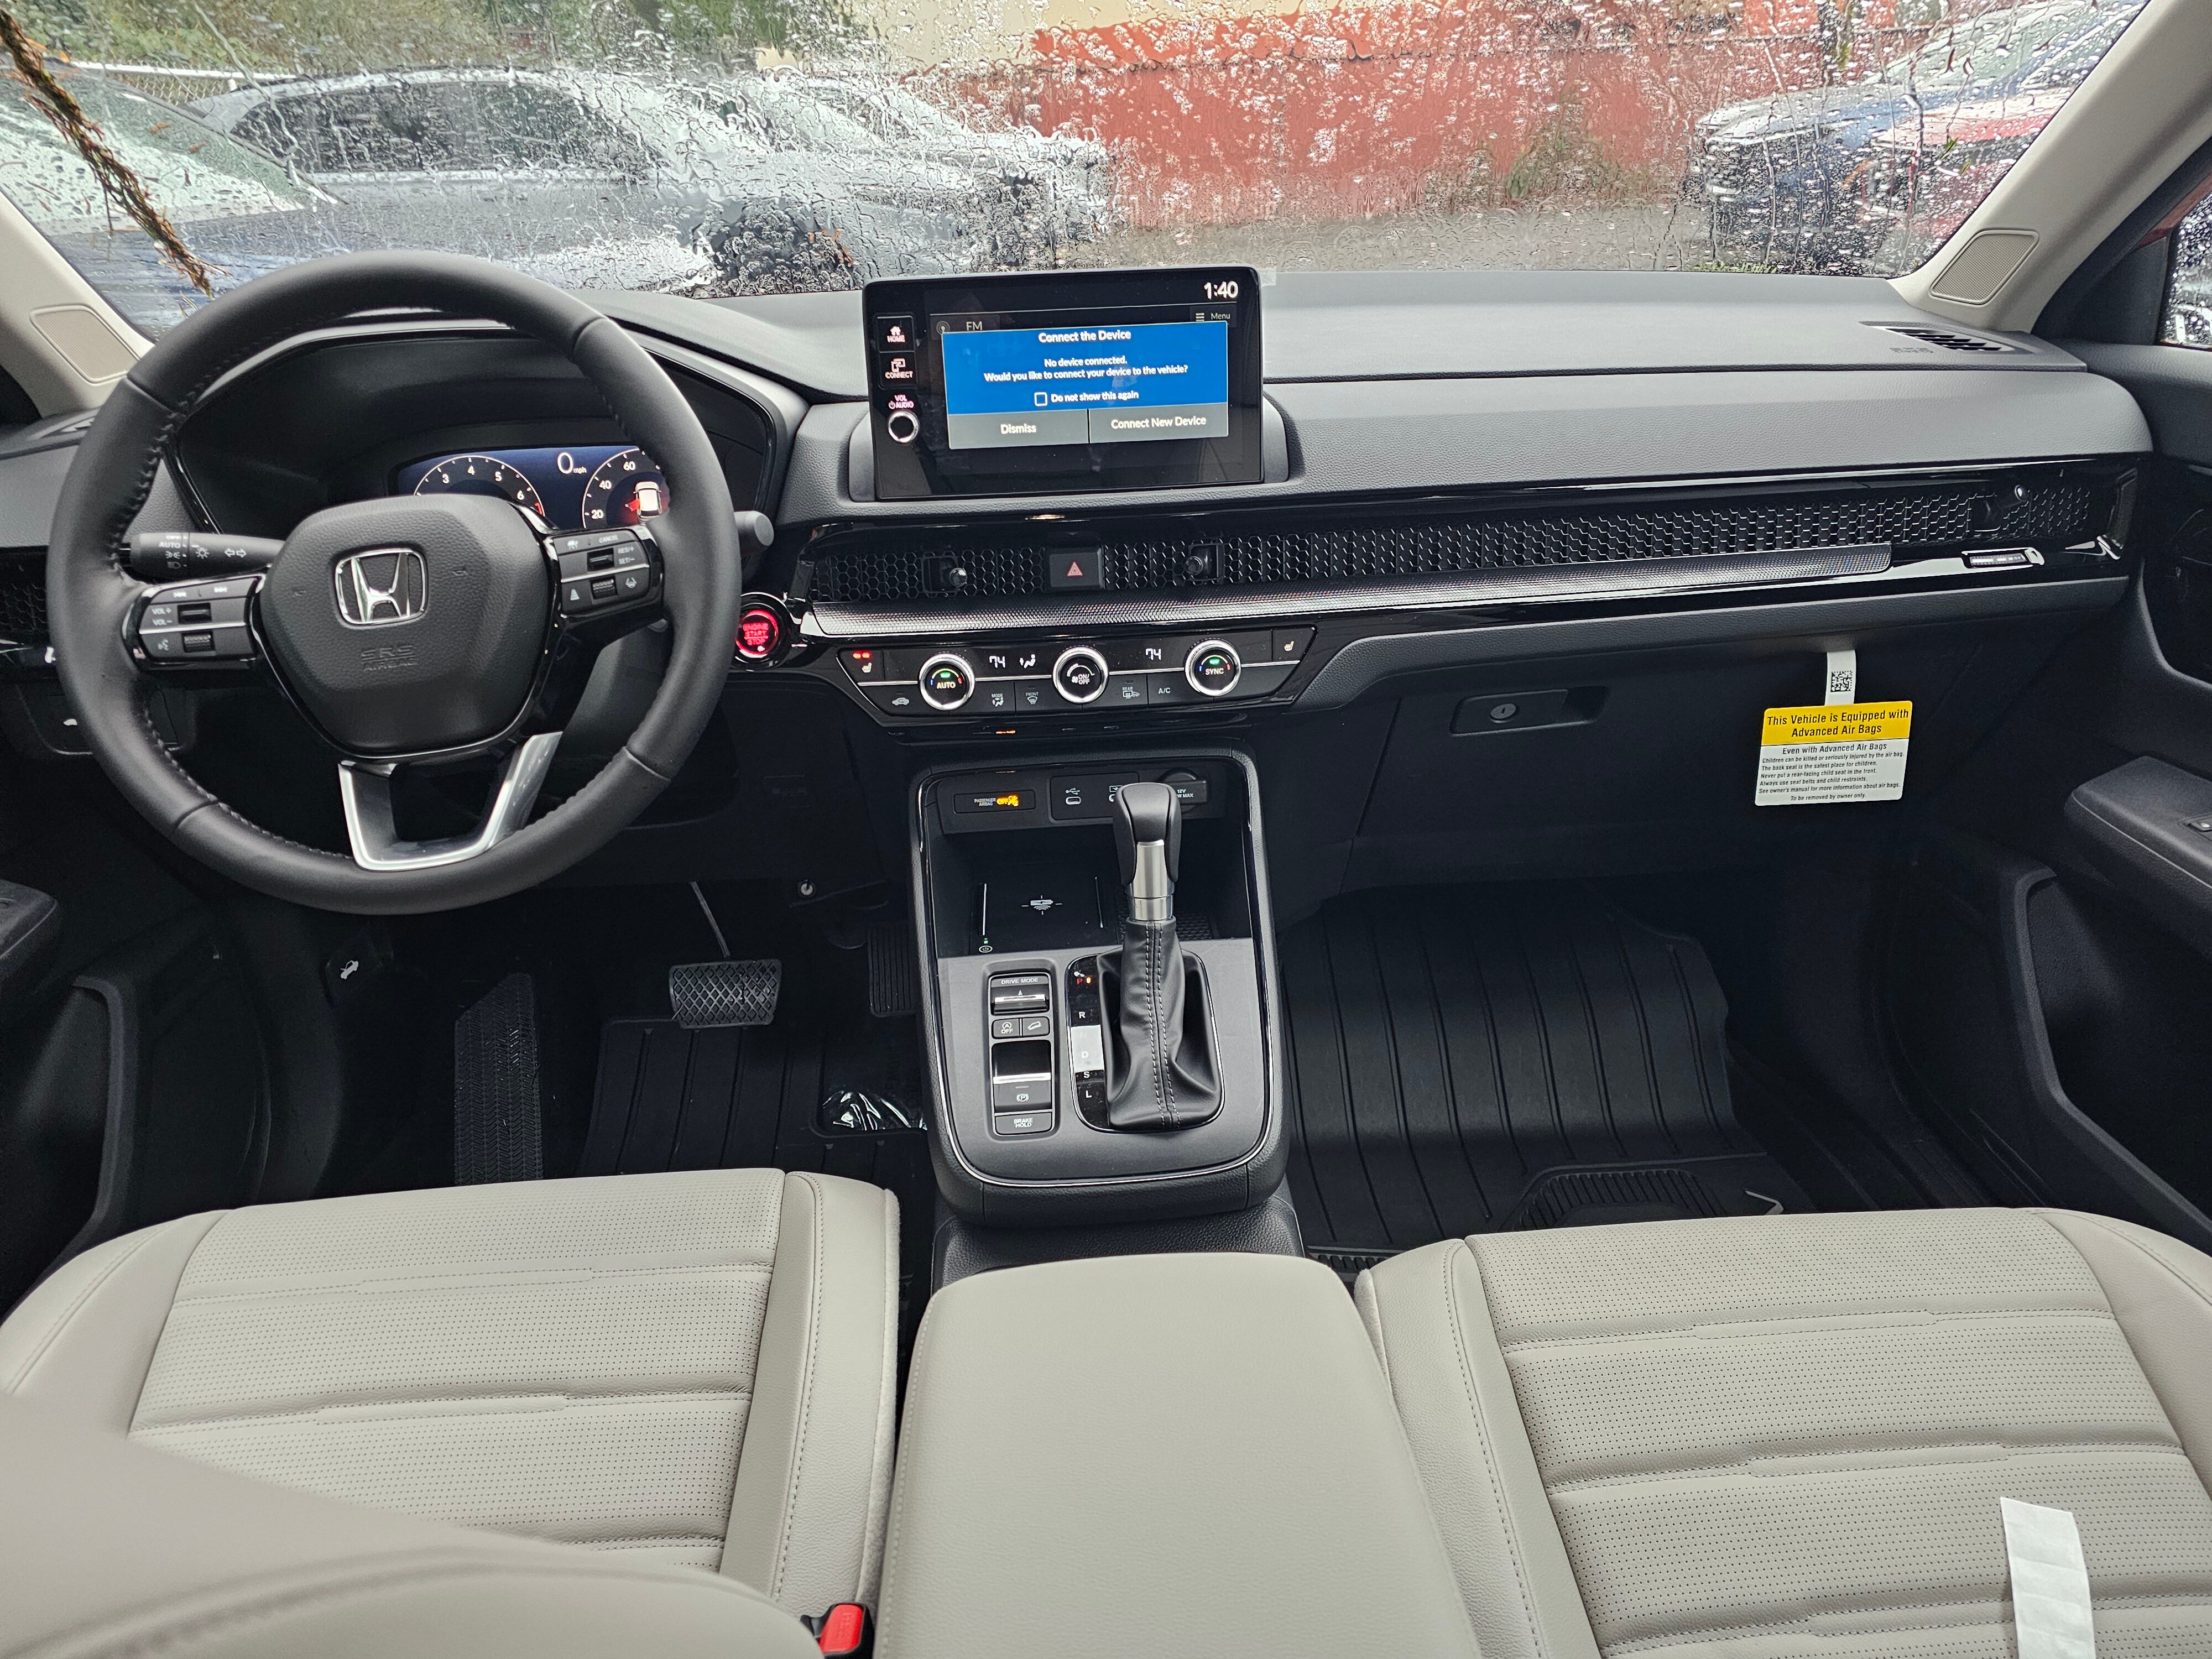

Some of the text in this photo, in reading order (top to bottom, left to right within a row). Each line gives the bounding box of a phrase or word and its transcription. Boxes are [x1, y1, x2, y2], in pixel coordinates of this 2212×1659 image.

[1204, 281, 1239, 299] 1:40
[966, 321, 983, 331] FM
[886, 335, 905, 343] HOME
[1038, 330, 1131, 343] Connect the Device
[1044, 356, 1128, 368] No device connected.
[885, 371, 913, 379] CONNECT
[983, 364, 1188, 382] Would you like to connect your device to the vehicle?
[1051, 391, 1139, 403] Do not show this again
[1110, 415, 1207, 430] Connect New Device
[1000, 424, 1037, 435] Dismiss
[557, 452, 587, 475] 0 mph
[623, 461, 636, 471] 60
[467, 465, 474, 476] 4
[442, 473, 450, 484] 3
[495, 471, 502, 482] 5
[599, 480, 612, 490] 40
[517, 491, 524, 500] 6
[591, 510, 603, 519] 20
[598, 534, 618, 544] CANCEL
[361, 645, 413, 661] SRS
[1145, 648, 1161, 661] 74
[989, 655, 1006, 668] 74
[1767, 709, 1908, 725] This Vehicle is Equipped with
[1792, 724, 1882, 737] Advanced Air Bags
